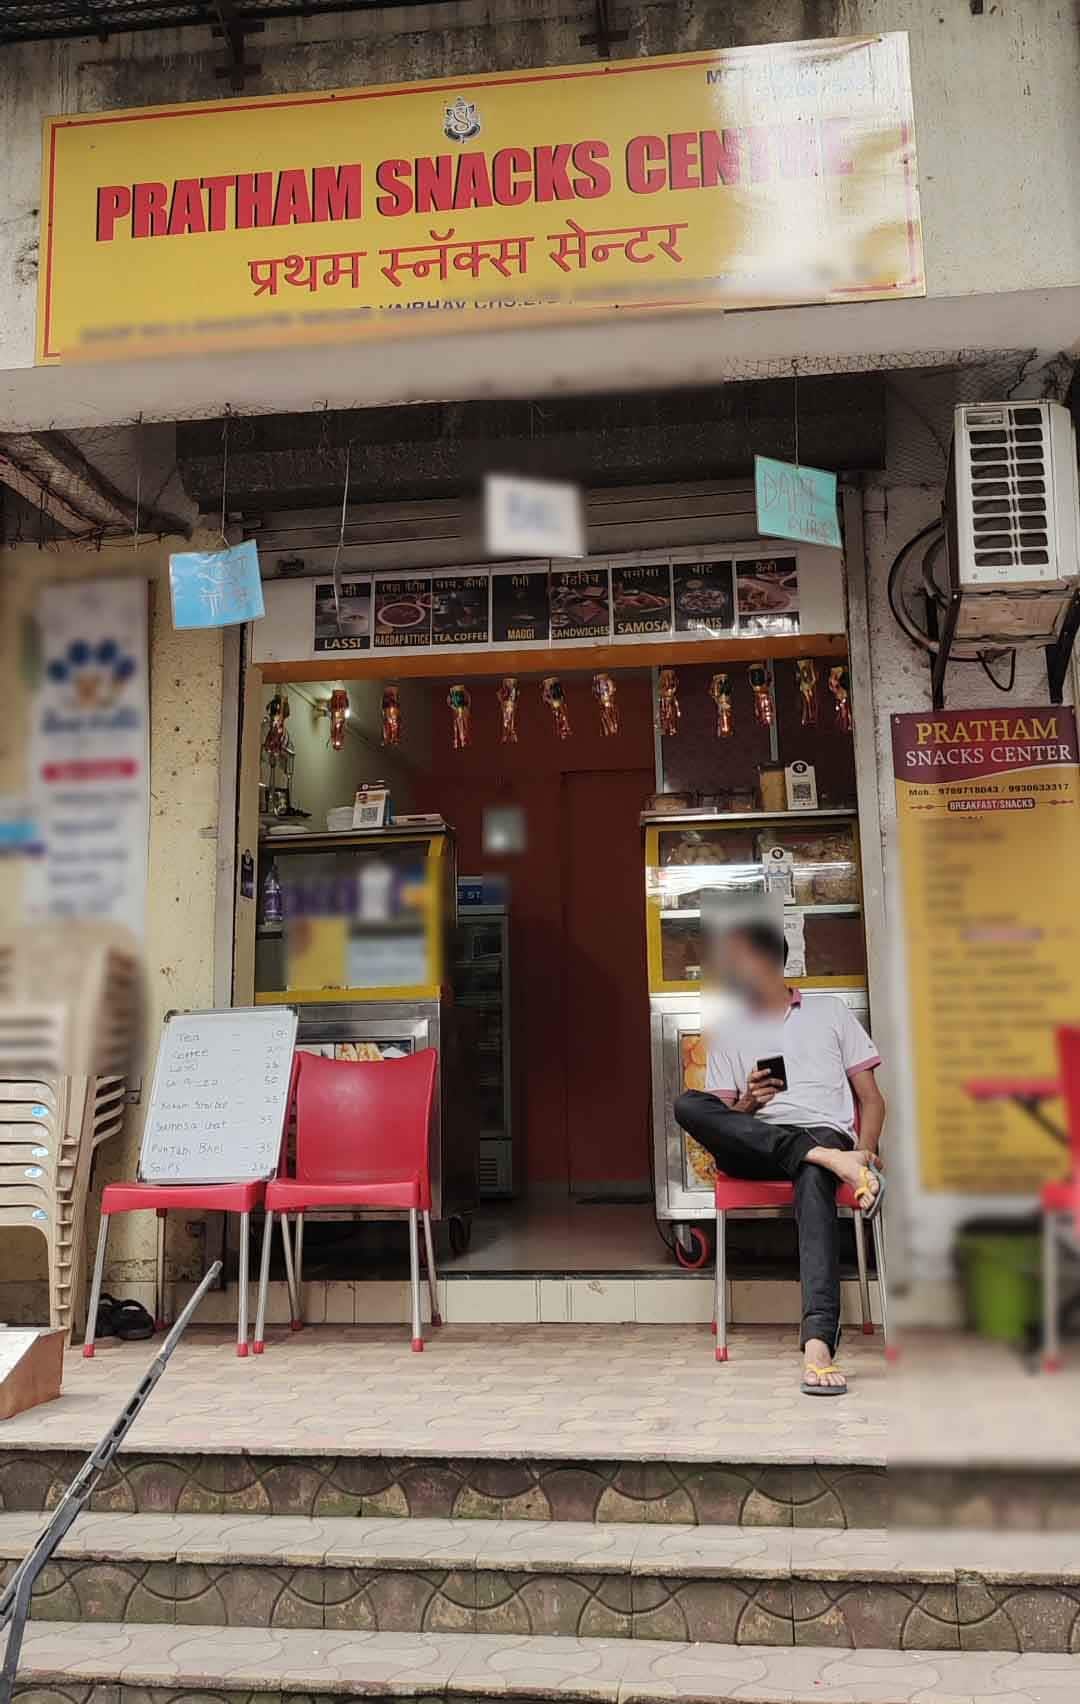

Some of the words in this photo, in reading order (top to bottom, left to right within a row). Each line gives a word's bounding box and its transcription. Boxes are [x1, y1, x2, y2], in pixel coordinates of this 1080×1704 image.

[96, 163, 363, 242] PRATHAM
[375, 140, 612, 217] SNACKS
[248, 251, 368, 297] प्रथम
[379, 228, 535, 287] स्नॅक्स
[546, 219, 689, 276] सेन्टर
[507, 628, 535, 641] MAGGI
[551, 625, 609, 639] SANDWICHES
[617, 620, 669, 634] SAMOSA
[324, 637, 361, 649] LASSI
[915, 717, 1059, 745] PRATHAM
[906, 747, 985, 767] SNACKS
[990, 744, 1073, 763] CENTER
